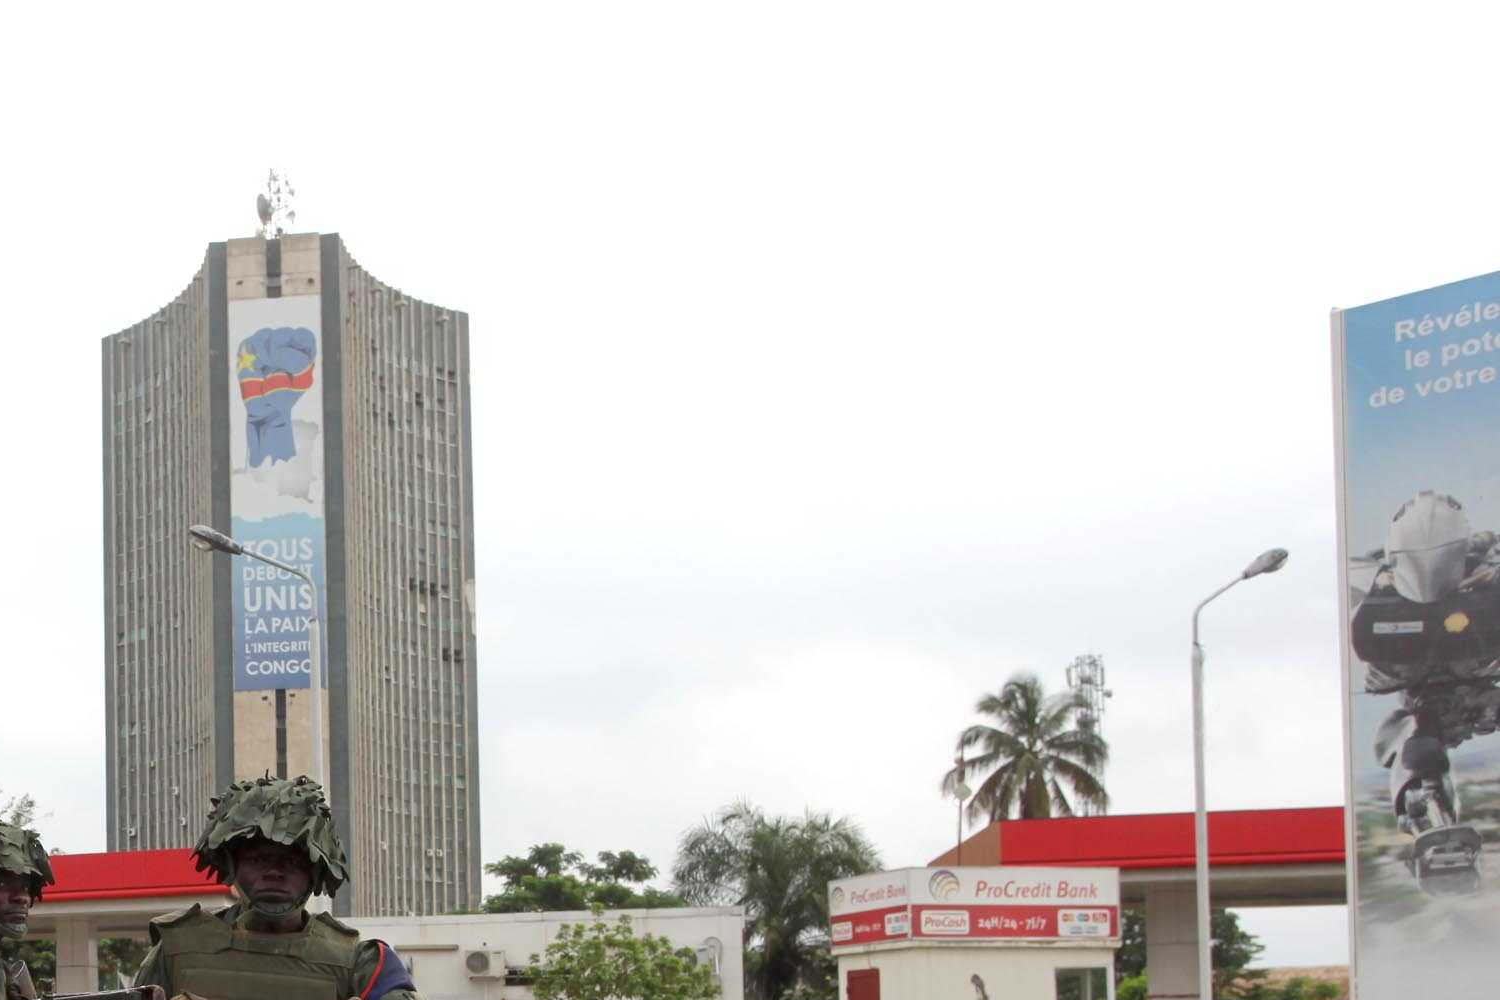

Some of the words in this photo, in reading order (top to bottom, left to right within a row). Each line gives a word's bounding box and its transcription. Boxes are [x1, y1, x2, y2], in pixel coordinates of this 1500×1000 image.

[1405, 349, 1431, 370] le
[1369, 386, 1405, 408] de
[1415, 366, 1496, 397] votre
[243, 538, 313, 562] TOUS
[243, 564, 314, 581] DEBOT
[244, 584, 312, 612] UNIS
[245, 617, 269, 634] LA
[271, 616, 311, 633] PAIX
[245, 640, 311, 654] L'INTEGRIT
[245, 659, 312, 676] CONGO
[887, 884, 908, 899] Bank
[974, 880, 1052, 899] ProCredit
[1057, 880, 1098, 899] Bank
[924, 916, 966, 929] ProCash
